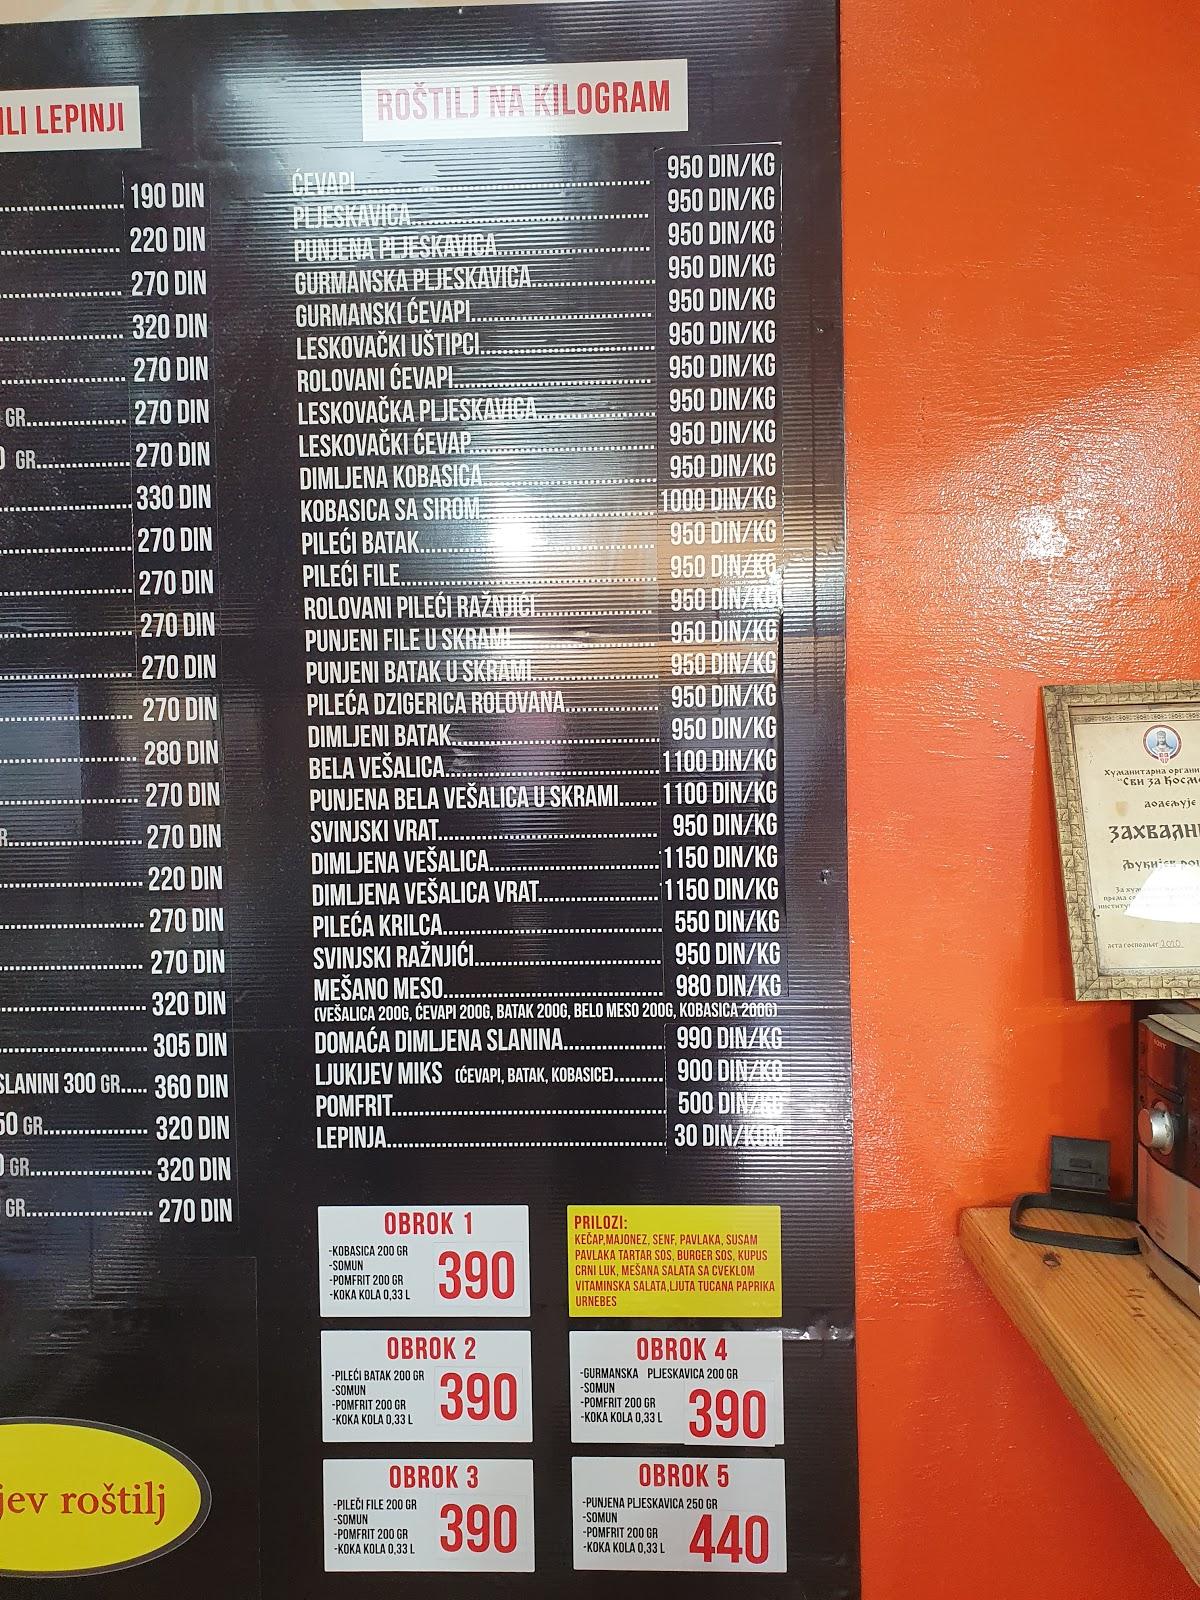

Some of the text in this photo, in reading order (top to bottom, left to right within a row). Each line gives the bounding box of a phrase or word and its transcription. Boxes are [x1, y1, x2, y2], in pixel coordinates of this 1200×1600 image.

[377, 80, 670, 121] ROŠTILJ NA KILOGRAM
[36, 102, 124, 133] LEPINJI
[291, 153, 775, 196] ĆEVAPI 950 DIN/KG
[131, 183, 204, 209] 190 DIN
[294, 205, 411, 229] PLJESKAVICA
[130, 227, 205, 252] 220 DIN
[295, 254, 775, 295] GURMANSKA PLJESKAVICA 950 DIN/KG
[133, 313, 207, 339] 320 DIN
[297, 329, 479, 360] LESKOVAČKI UŠTIPCI
[135, 400, 209, 425] 270 DIN
[298, 397, 537, 425] LESKOVAČKA PLJESKAVICA
[301, 487, 776, 522] KOBASICA SA SIROM 1000 DIN/KG
[303, 560, 399, 588] PILEĆI FILE
[307, 658, 532, 684] PUNJENI BATAK U SKRAMI
[308, 689, 565, 716] PILEĆA DZIGERICA ROLOVANA
[144, 740, 219, 765] 280 DIN
[309, 751, 445, 780] BELA VEŠALICA
[310, 781, 778, 811] PUNJENA BELA VEŠALICA U SKRAMI 1100 DIN/KG
[312, 845, 489, 875] DIMLJENA VEŠALICA
[313, 910, 780, 937] PILEĆA KRILCA 550 DIN/KG
[314, 973, 781, 1000] MEŠANO MESO 980 DIN/KG
[314, 1002, 375, 1022] (VEŠALICA
[379, 1005, 412, 1021] 200G,
[415, 1002, 456, 1020] ĆEVAPI
[460, 1004, 493, 1020] 200G,
[497, 1004, 533, 1019] BATAK
[537, 1003, 570, 1019] 200G,
[574, 1003, 603, 1018] BELO
[606, 1003, 639, 1018] MESO
[643, 1002, 676, 1018] 200G,
[680, 1002, 738, 1018] KOBASICA
[153, 1033, 227, 1057] 305 DIN
[315, 1026, 562, 1054] DOMAĆA DIMLJENA SLANINA
[316, 1059, 783, 1085] LJUKIJEV MIKS (ĆEVAPI, BATAK, KOBASICE) 900 DIN/KG
[63, 1073, 96, 1094] 300
[100, 1075, 121, 1094] GR
[154, 1074, 191, 1098] 360
[196, 1074, 228, 1097] DIN
[316, 1094, 392, 1117] POMFRIT
[317, 1126, 386, 1148] LEPINJA
[158, 1199, 232, 1222] 270 DIN
[385, 1212, 472, 1234] OBROK 1
[574, 1216, 628, 1229] PRILOZI:
[329, 1246, 408, 1257] -KOBASICA 200 GR
[653, 1235, 677, 1245] SENF,
[680, 1235, 723, 1245] PAVLAKA,
[726, 1235, 757, 1245] SUSAM
[329, 1260, 363, 1271] -SOMUN
[575, 1250, 768, 1261] PAVLAKA TARTAR SOS, BURGER SOS, KUPUS
[329, 1275, 403, 1285] -POMFRIT 200 GR
[439, 1251, 515, 1299] 390
[575, 1263, 754, 1276] CRNI LUK, MEŠANA SALATA SA CVEKLOM
[330, 1290, 410, 1301] -KOKA KOLA 0,33 L
[576, 1281, 631, 1291] VITAMINSKA
[698, 1281, 734, 1291] TUCANA
[736, 1281, 775, 1291] PAPRIKA
[576, 1296, 617, 1307] URNEBES
[639, 1464, 729, 1487] OBROK 5
[61, 1481, 166, 1525] roštilj
[583, 1498, 718, 1509] -PUNJENA PLJESKAVICA 250 GR
[690, 1514, 769, 1564] 440
